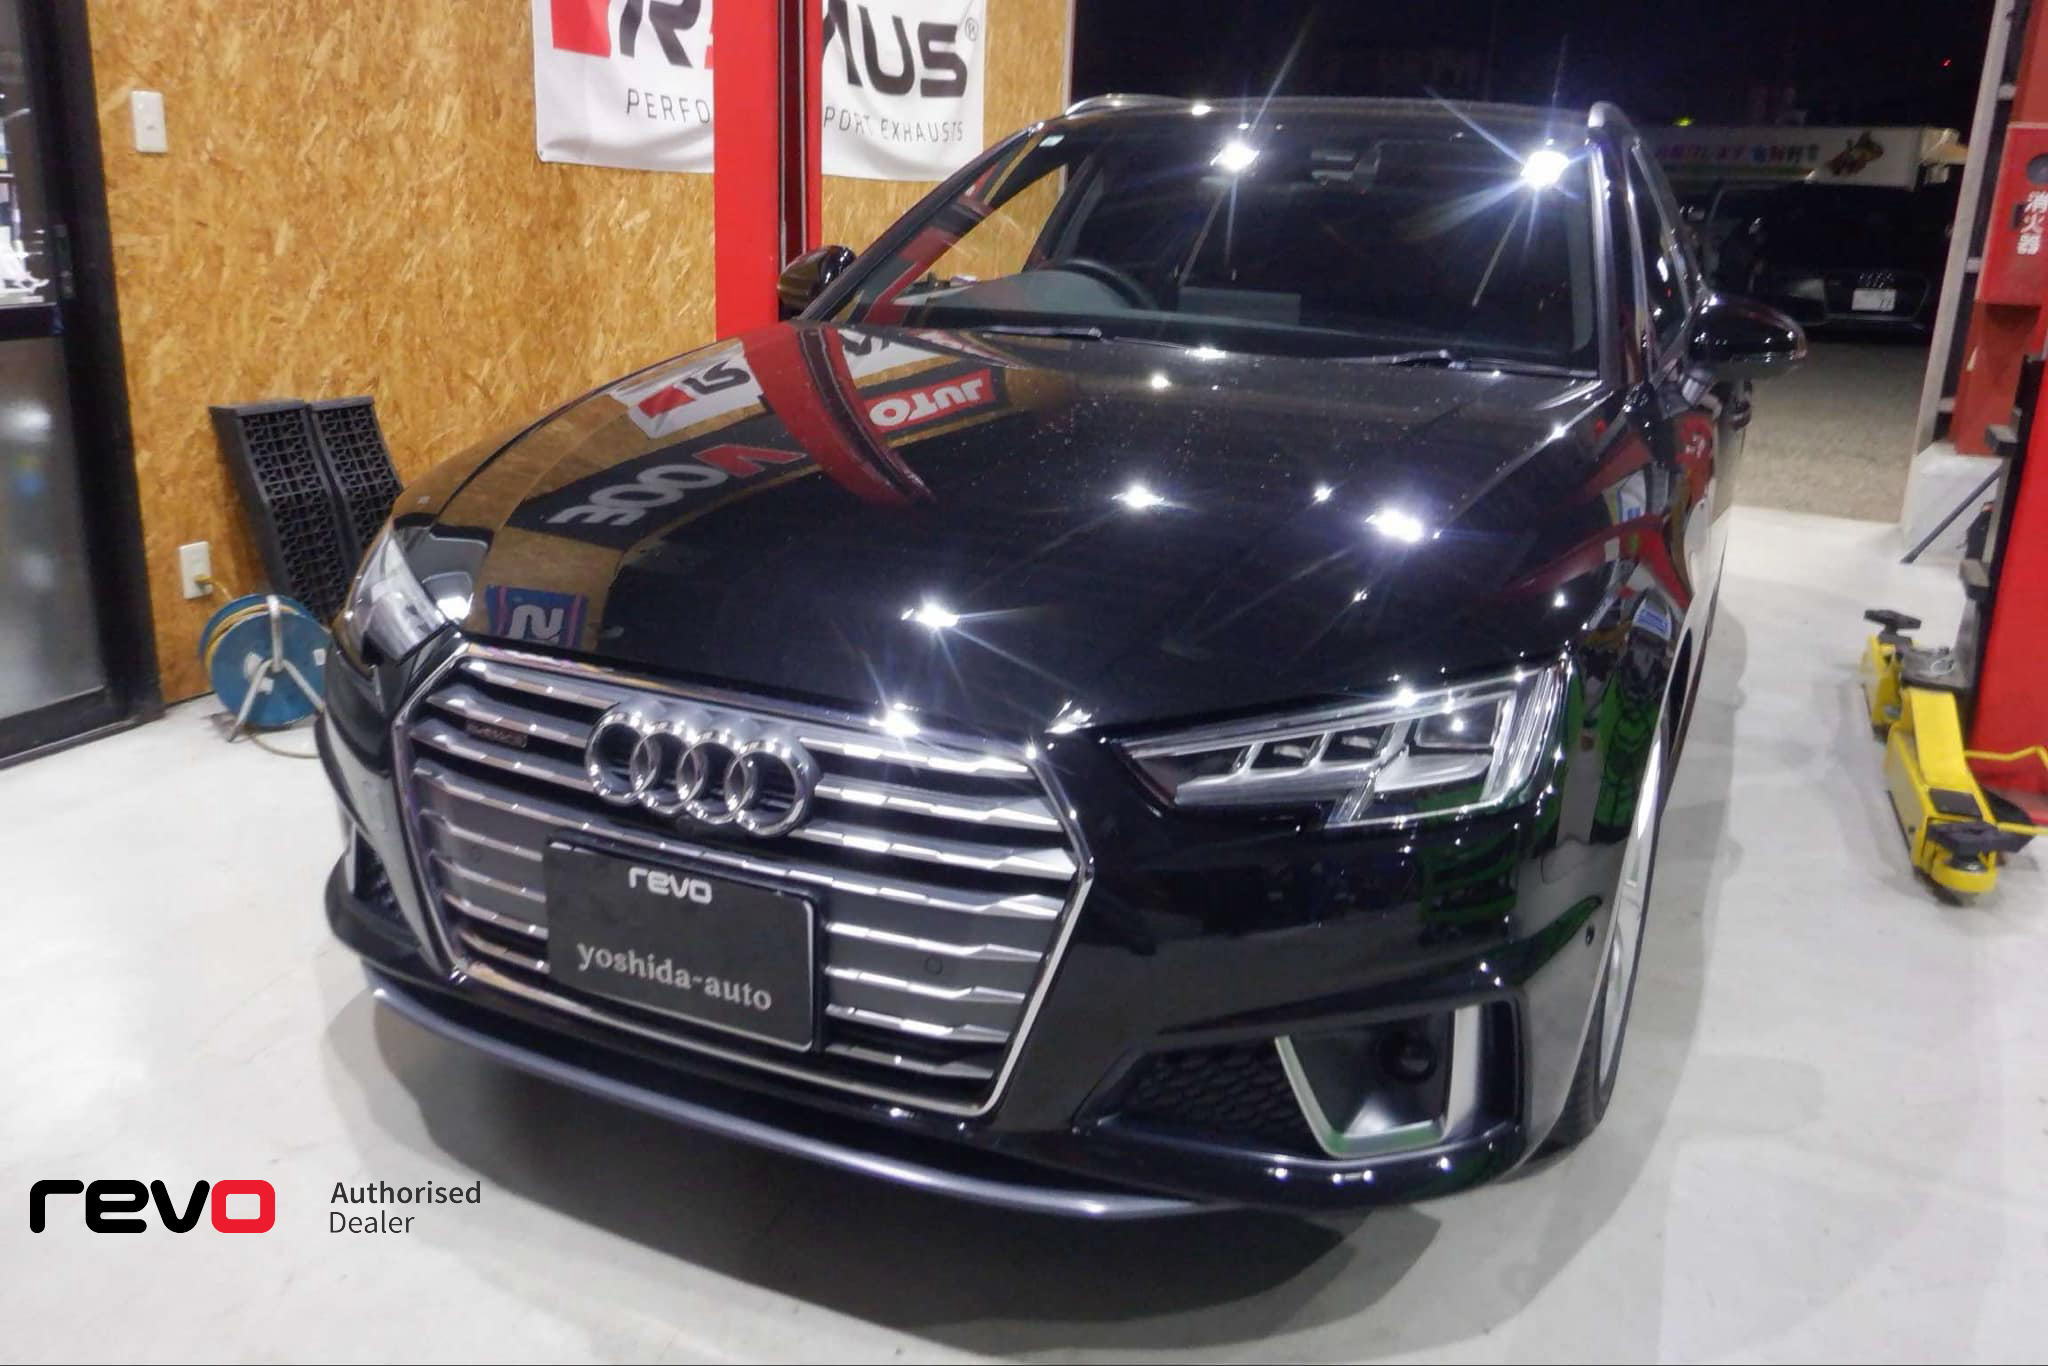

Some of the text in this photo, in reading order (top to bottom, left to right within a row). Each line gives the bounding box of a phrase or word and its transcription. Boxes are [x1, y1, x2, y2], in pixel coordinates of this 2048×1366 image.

[824, 107, 871, 136] PORT
[881, 119, 964, 143] EXHAUSTS
[2016, 191, 2048, 255] 消火器
[629, 867, 712, 904] revo
[577, 943, 772, 1010] yoshida-auto
